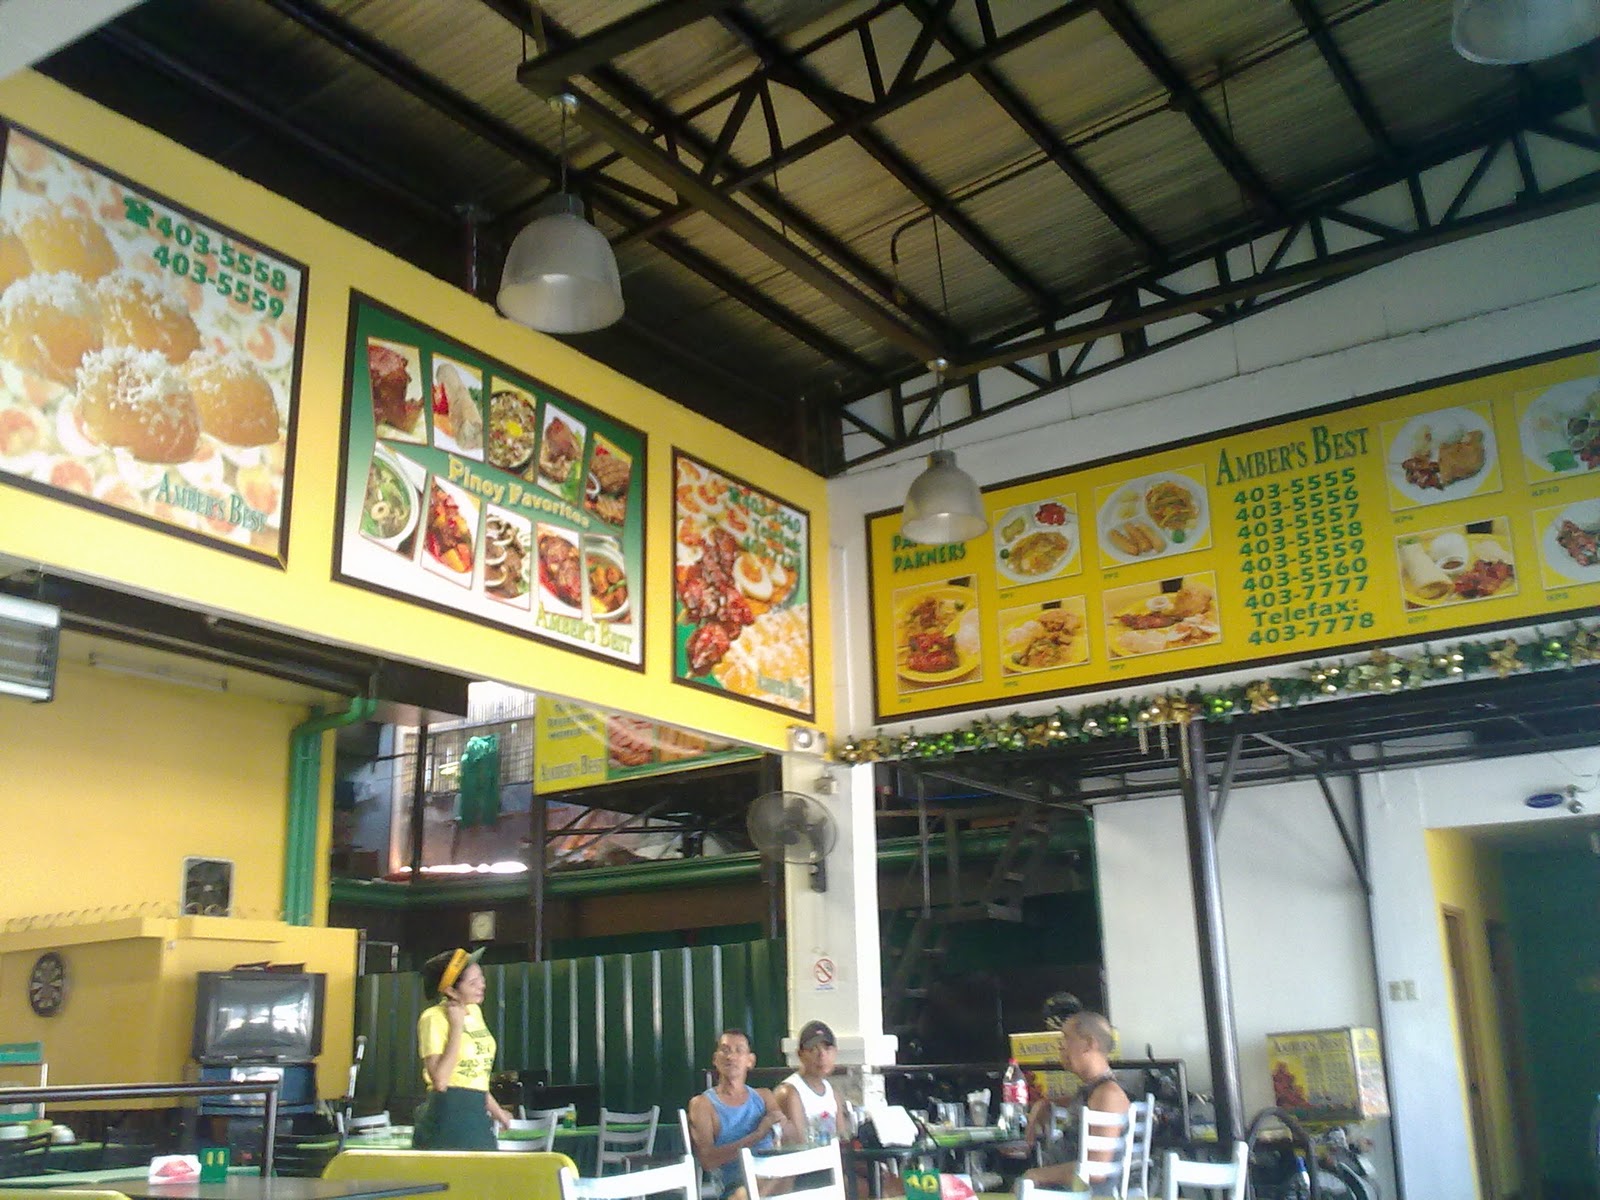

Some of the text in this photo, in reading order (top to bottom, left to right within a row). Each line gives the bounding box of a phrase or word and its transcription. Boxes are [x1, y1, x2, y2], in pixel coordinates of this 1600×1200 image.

[157, 216, 286, 291] 403-5558
[153, 245, 284, 318] 403-5559
[1312, 425, 1368, 464] BEST
[448, 454, 590, 528] Pinoy Favorites
[1234, 467, 1356, 504] 403-5555
[1236, 485, 1358, 522] 403-5556
[1237, 503, 1360, 539] 403-5557
[1239, 521, 1362, 556] 403-5558
[1241, 539, 1364, 574] 403-5559
[1243, 557, 1367, 591] 403-5560
[1245, 575, 1368, 609] 403-7777
[1248, 612, 1375, 645] 403-7778
[1251, 598, 1359, 627] Telefax:
